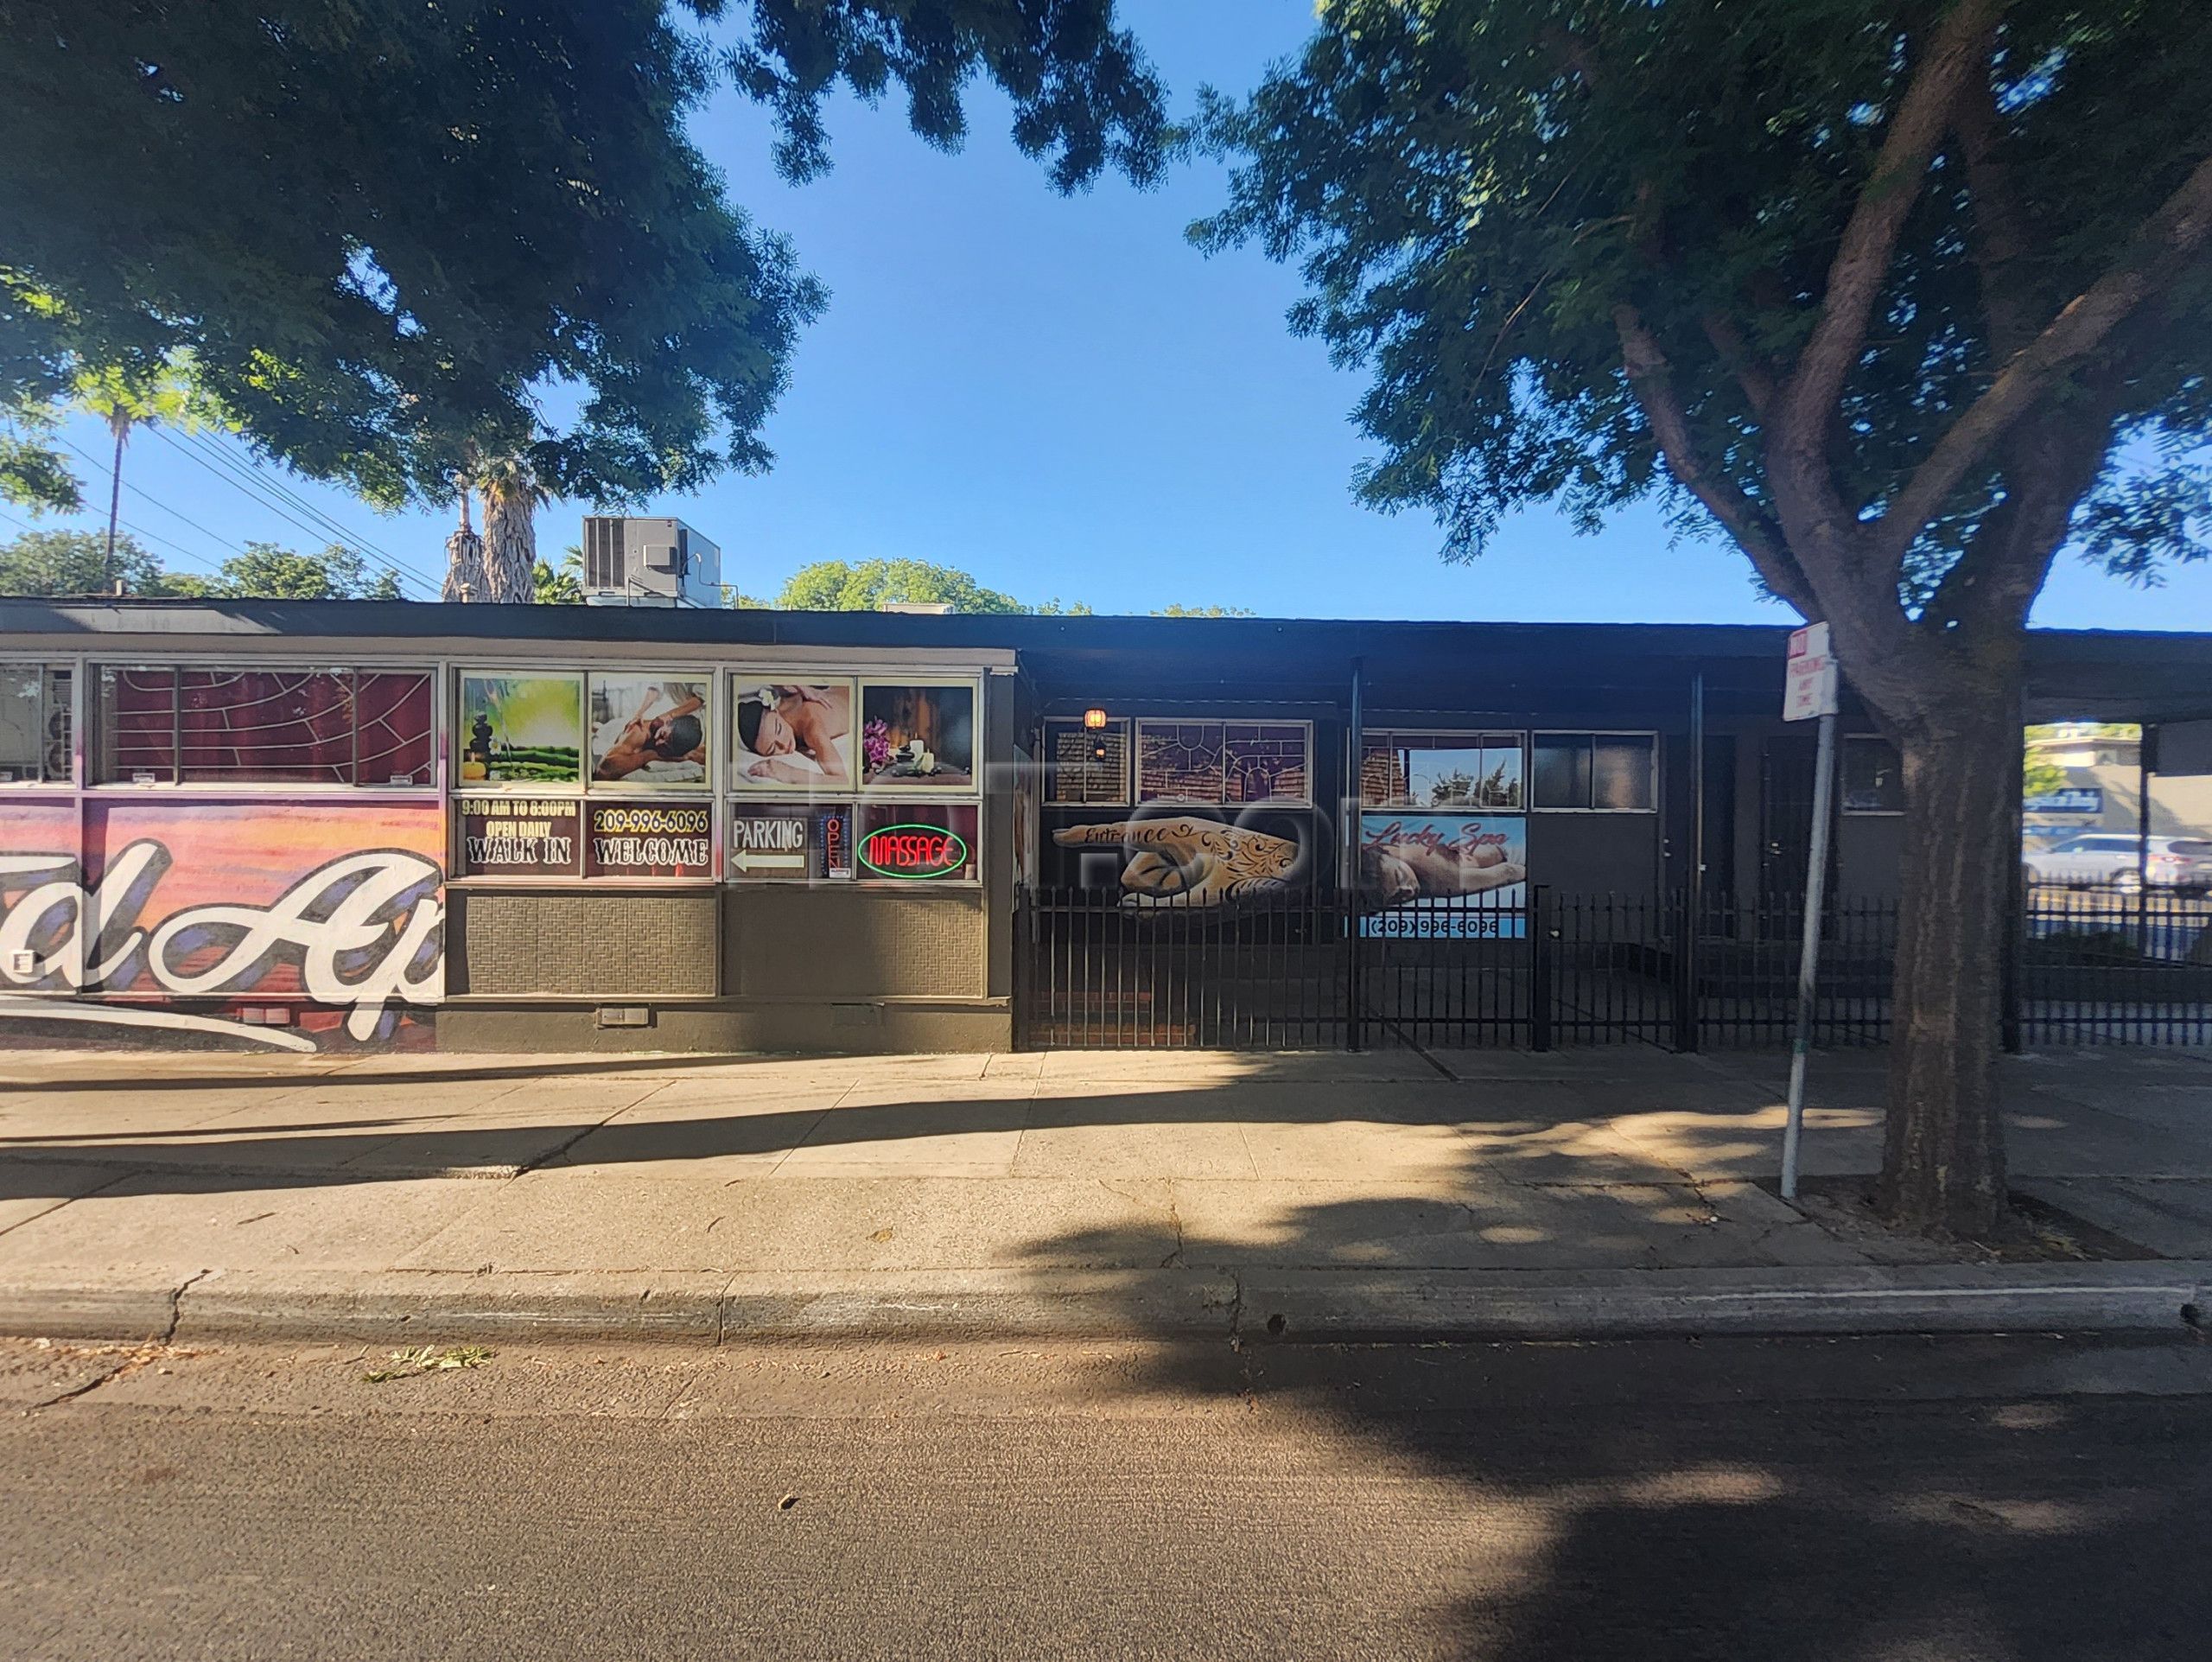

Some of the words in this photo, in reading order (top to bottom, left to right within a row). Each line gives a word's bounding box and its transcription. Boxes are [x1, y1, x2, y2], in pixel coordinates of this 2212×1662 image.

[461, 800, 488, 816] 9:00
[491, 800, 510, 816] AM
[512, 800, 527, 816] TO
[594, 809, 708, 833] 209-996-6096
[486, 821, 517, 837] OPEN
[519, 821, 551, 837] DAILY
[734, 820, 804, 849] PARKING
[1365, 821, 1446, 856] Lucky
[1449, 822, 1510, 855] Spa
[467, 837, 538, 864] WALK
[543, 837, 571, 864] IN
[593, 837, 709, 866] WELCOME
[827, 819, 841, 868] OPEN
[869, 836, 953, 866] MASSAGE
[1371, 919, 1416, 934] (209)
[1420, 920, 1498, 934] 996-6096
